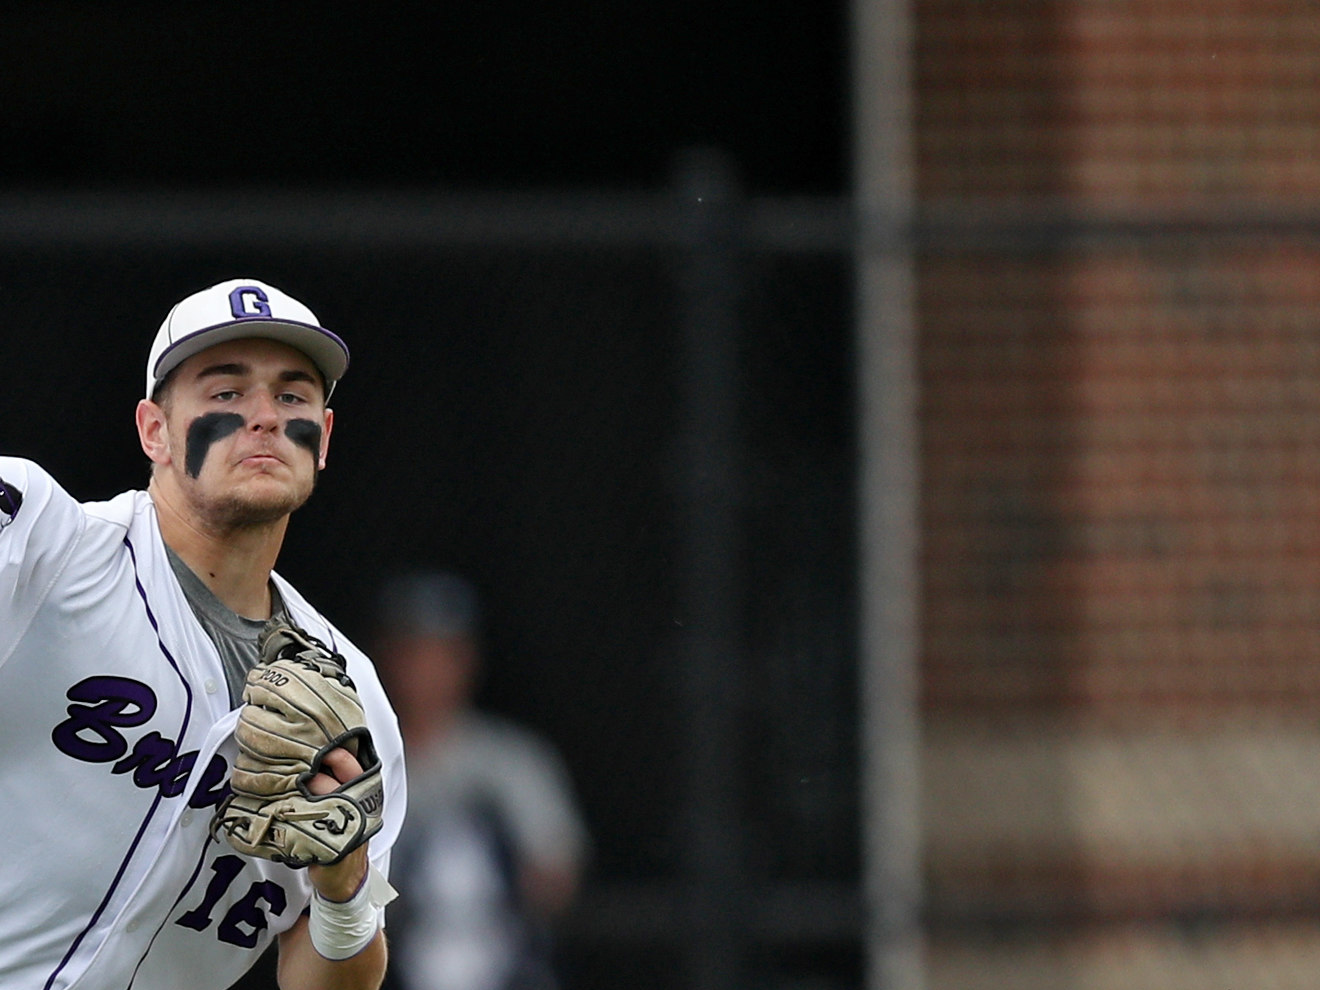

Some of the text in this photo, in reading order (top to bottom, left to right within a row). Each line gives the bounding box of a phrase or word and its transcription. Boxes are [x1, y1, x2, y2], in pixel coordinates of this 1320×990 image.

[229, 286, 272, 318] G
[51, 675, 234, 812] Bra
[175, 854, 288, 949] 16
